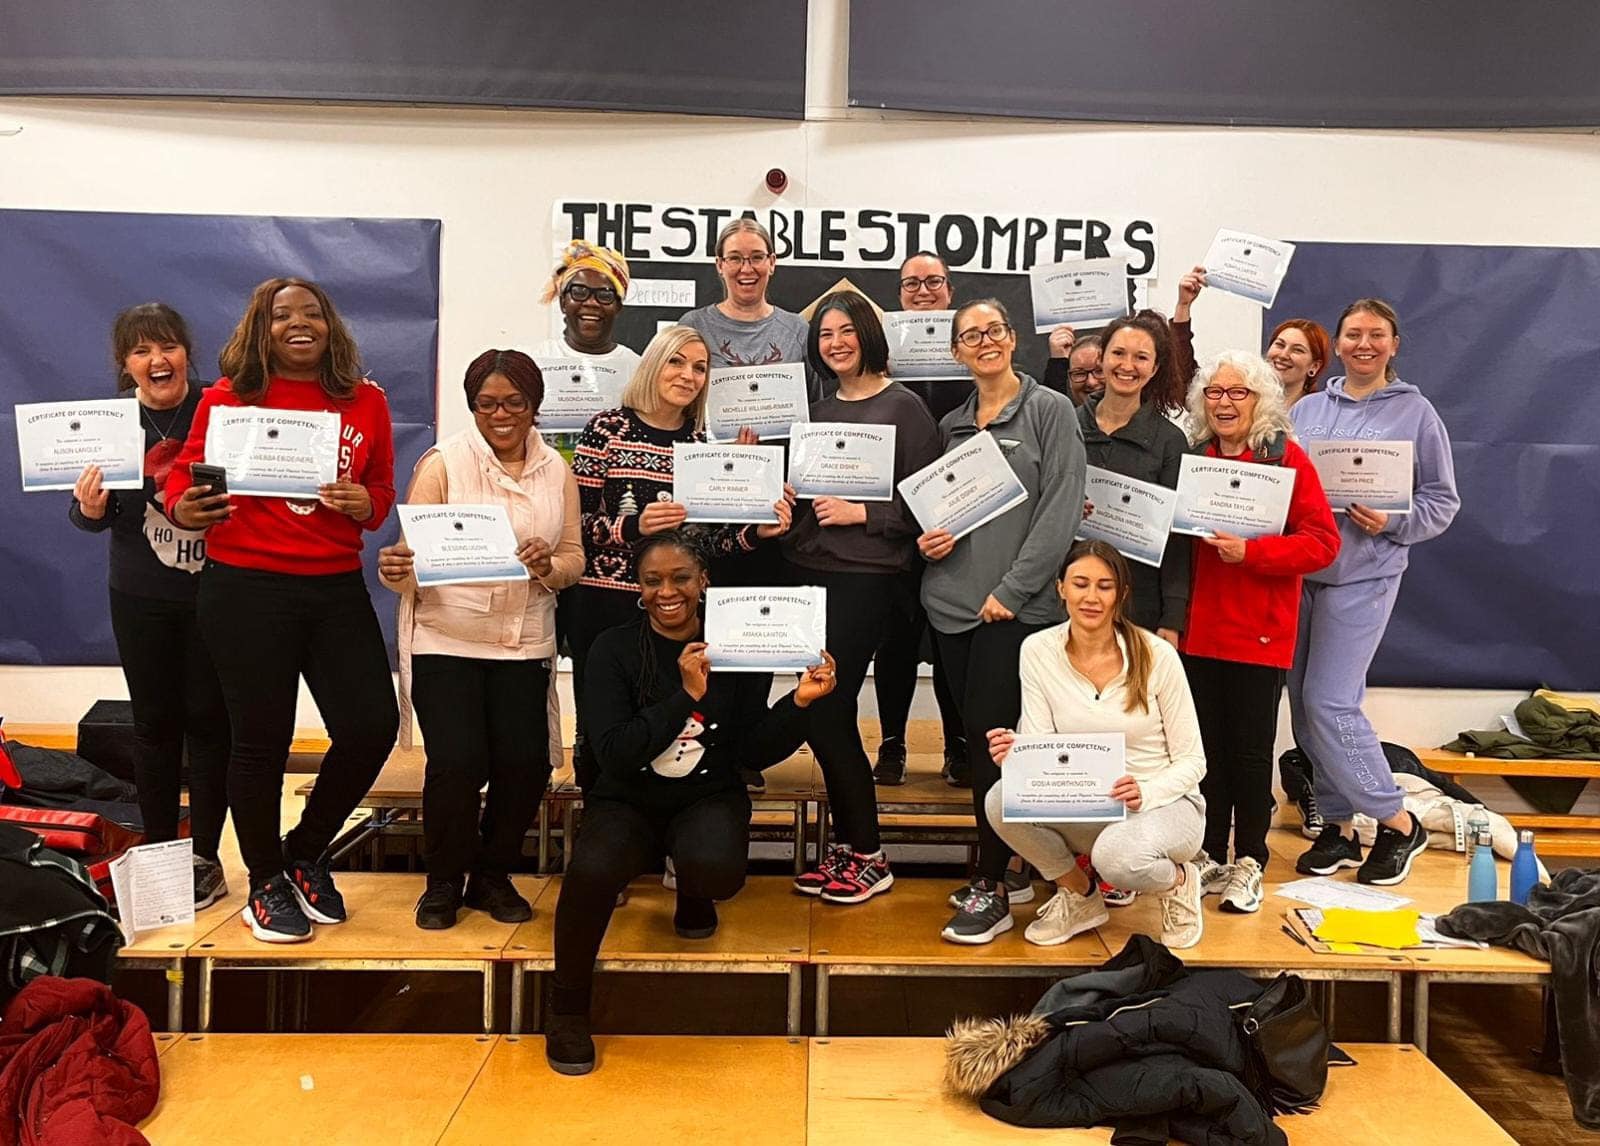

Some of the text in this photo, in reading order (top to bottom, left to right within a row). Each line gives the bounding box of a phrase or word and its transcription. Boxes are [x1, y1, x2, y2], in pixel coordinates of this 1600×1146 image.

[563, 203, 652, 258] THE
[858, 210, 1155, 275] STOMPERS
[711, 374, 745, 386] CERTIFICATE
[755, 372, 793, 380] COMPETENCY
[722, 406, 747, 414] MICHELLE
[28, 411, 66, 424] CERTIFICATE
[78, 409, 124, 419] COMPETENCY
[223, 417, 264, 427] CERTIFICTE
[800, 431, 834, 440] CERTIFICATE
[844, 431, 882, 441] COMPETENCY
[684, 452, 721, 461] CERTIFICATE
[731, 452, 771, 463] COMPETENCY
[1318, 448, 1351, 457] CERTIFICATE
[1361, 448, 1400, 457] COMPETENCY
[911, 471, 938, 496] CERTIFICATE
[938, 465, 945, 474] OF
[946, 447, 982, 468] COMPETENCY
[1191, 466, 1229, 475] CERTIFICATE
[1240, 470, 1281, 485] COMPETENCY
[1091, 478, 1122, 489] CERTIFICATE
[1131, 487, 1164, 506] COMPETENCY
[1210, 500, 1255, 512] SANDRA TAYLOR
[411, 512, 447, 522] CERTIFICATE
[458, 512, 496, 522] COMPETENCY
[154, 528, 173, 543] HO
[177, 539, 206, 563] HO
[717, 595, 756, 606] CERTIFICATE
[768, 595, 811, 606] COMPETENCY
[1013, 744, 1054, 753] CERTIFICATE
[1066, 743, 1111, 753] COMPETENCY
